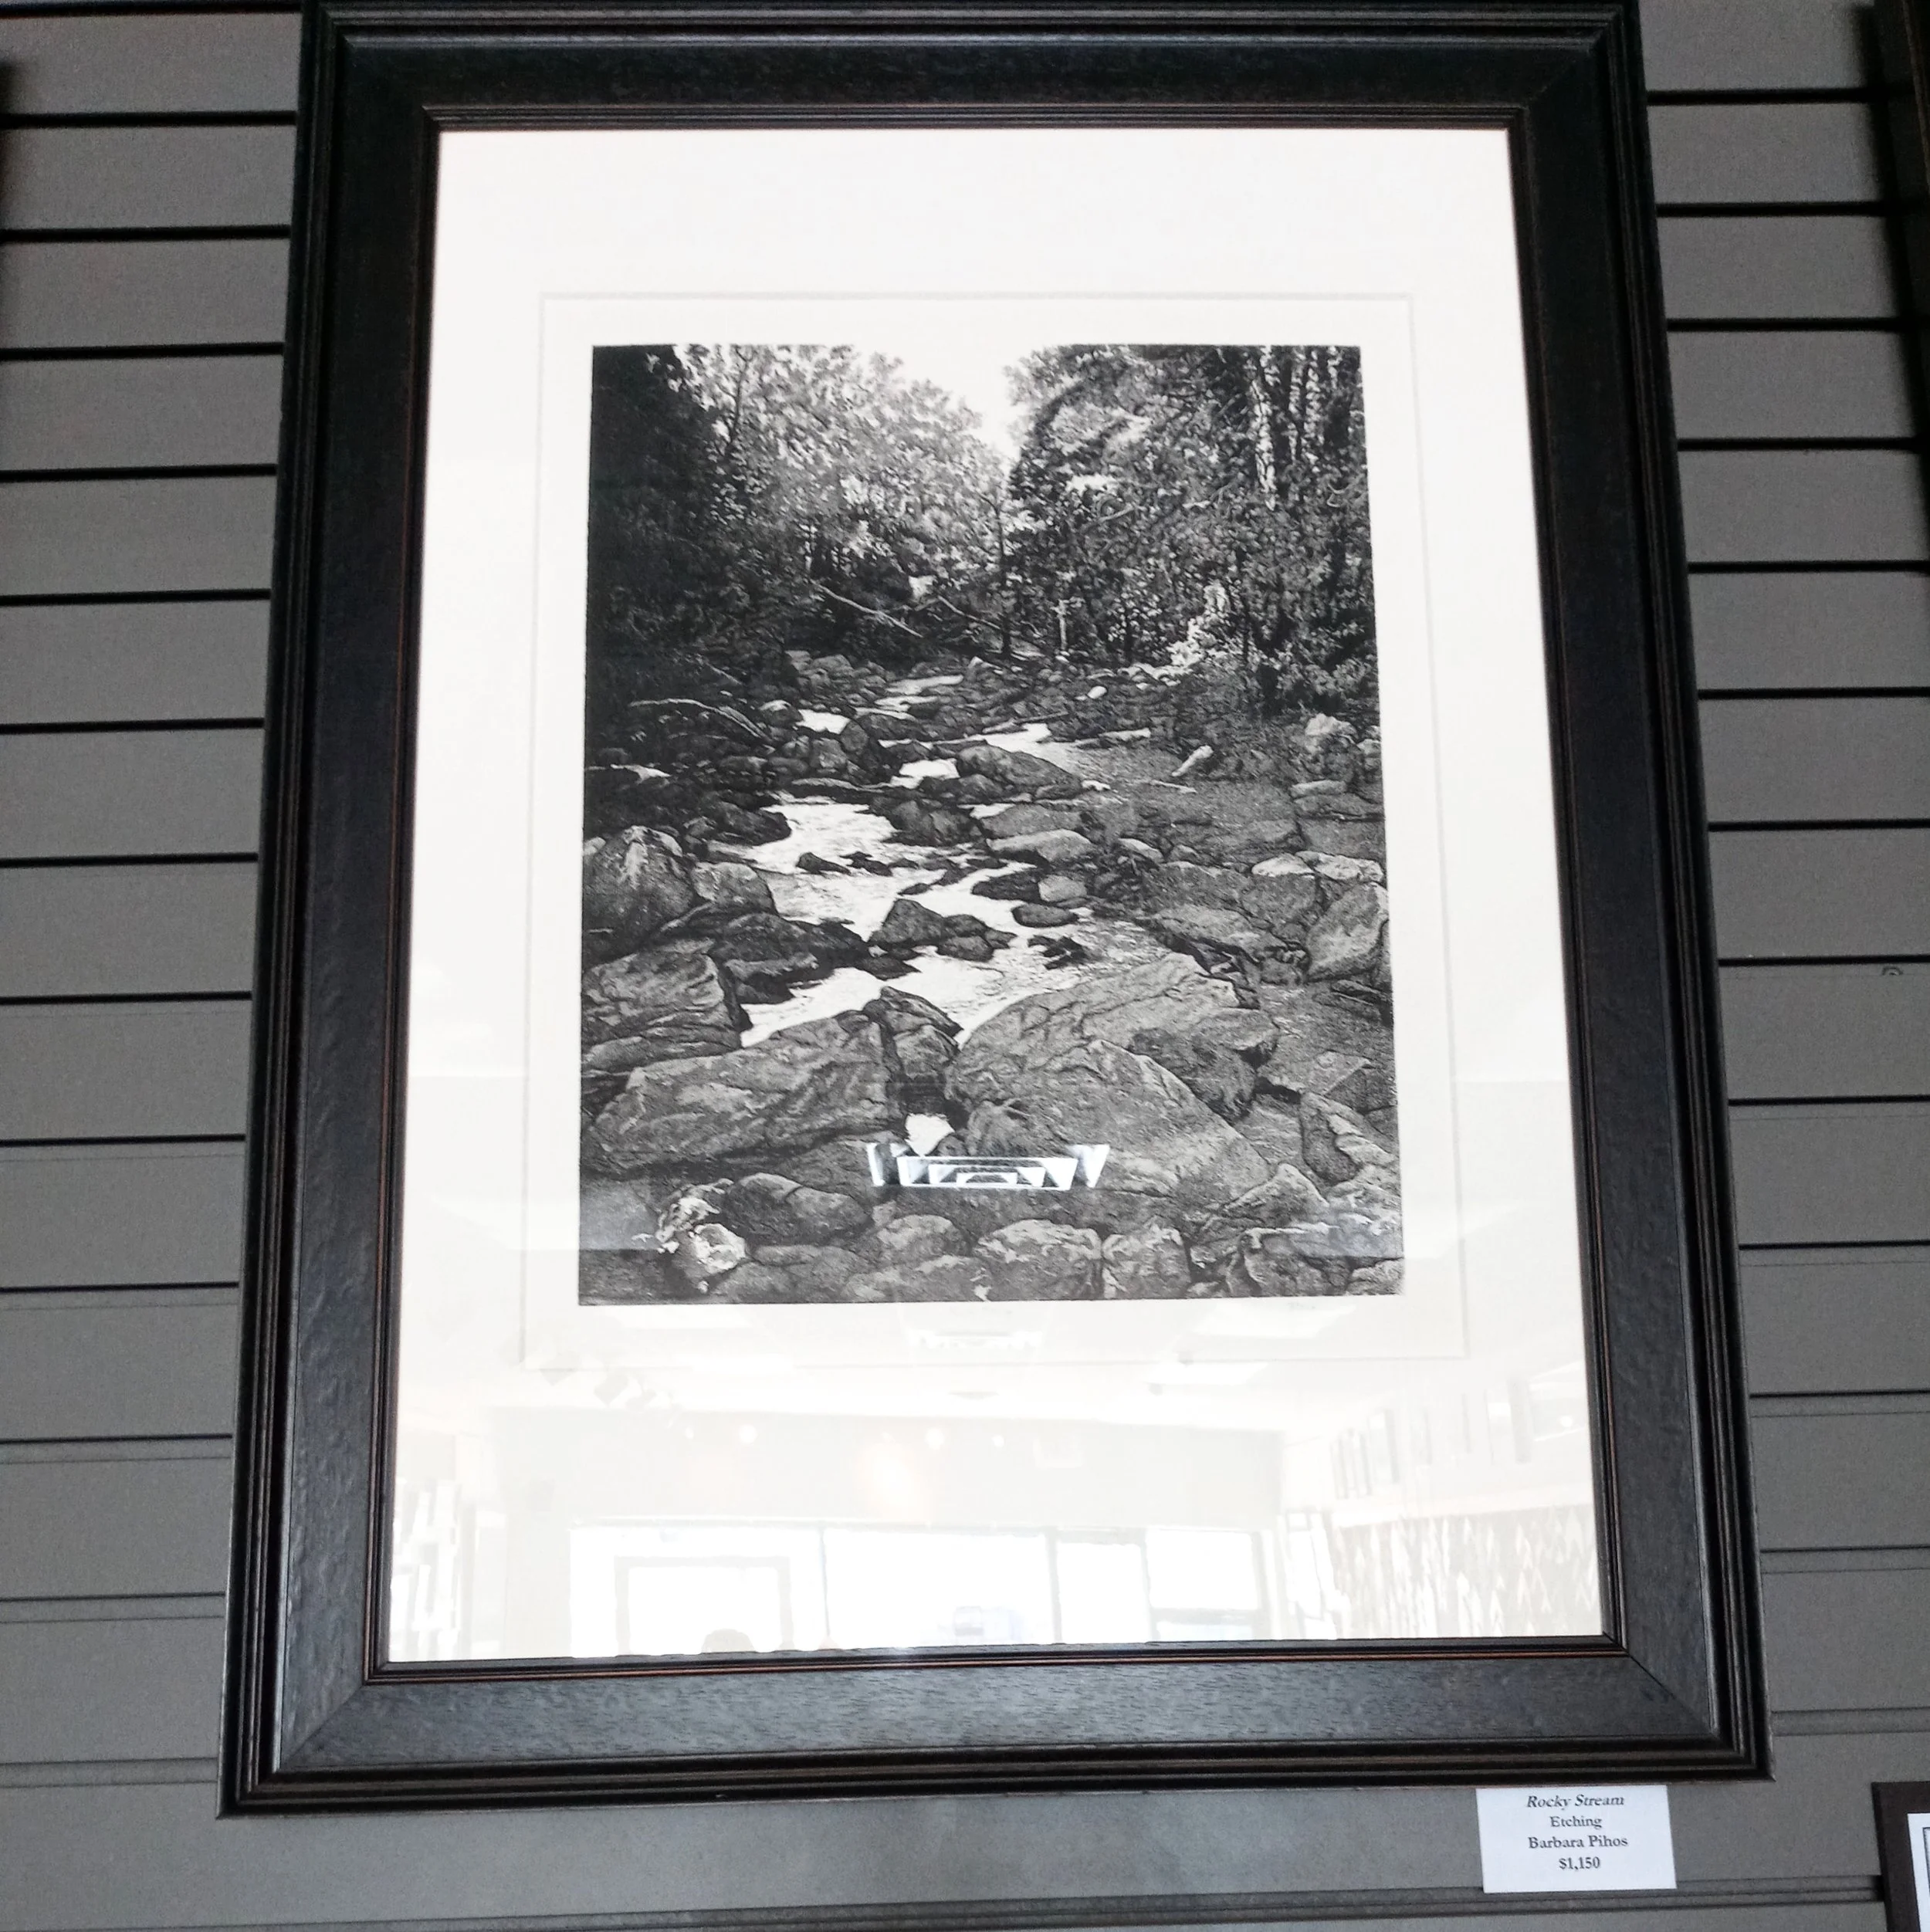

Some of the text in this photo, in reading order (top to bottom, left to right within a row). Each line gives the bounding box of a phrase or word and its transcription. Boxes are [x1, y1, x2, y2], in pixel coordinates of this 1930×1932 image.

[1526, 1794, 1625, 1810] Rocky Stream
[1549, 1815, 1603, 1829] Etching
[1528, 1834, 1629, 1849] Barbara Pihos
[1559, 1856, 1600, 1870] $1,150
